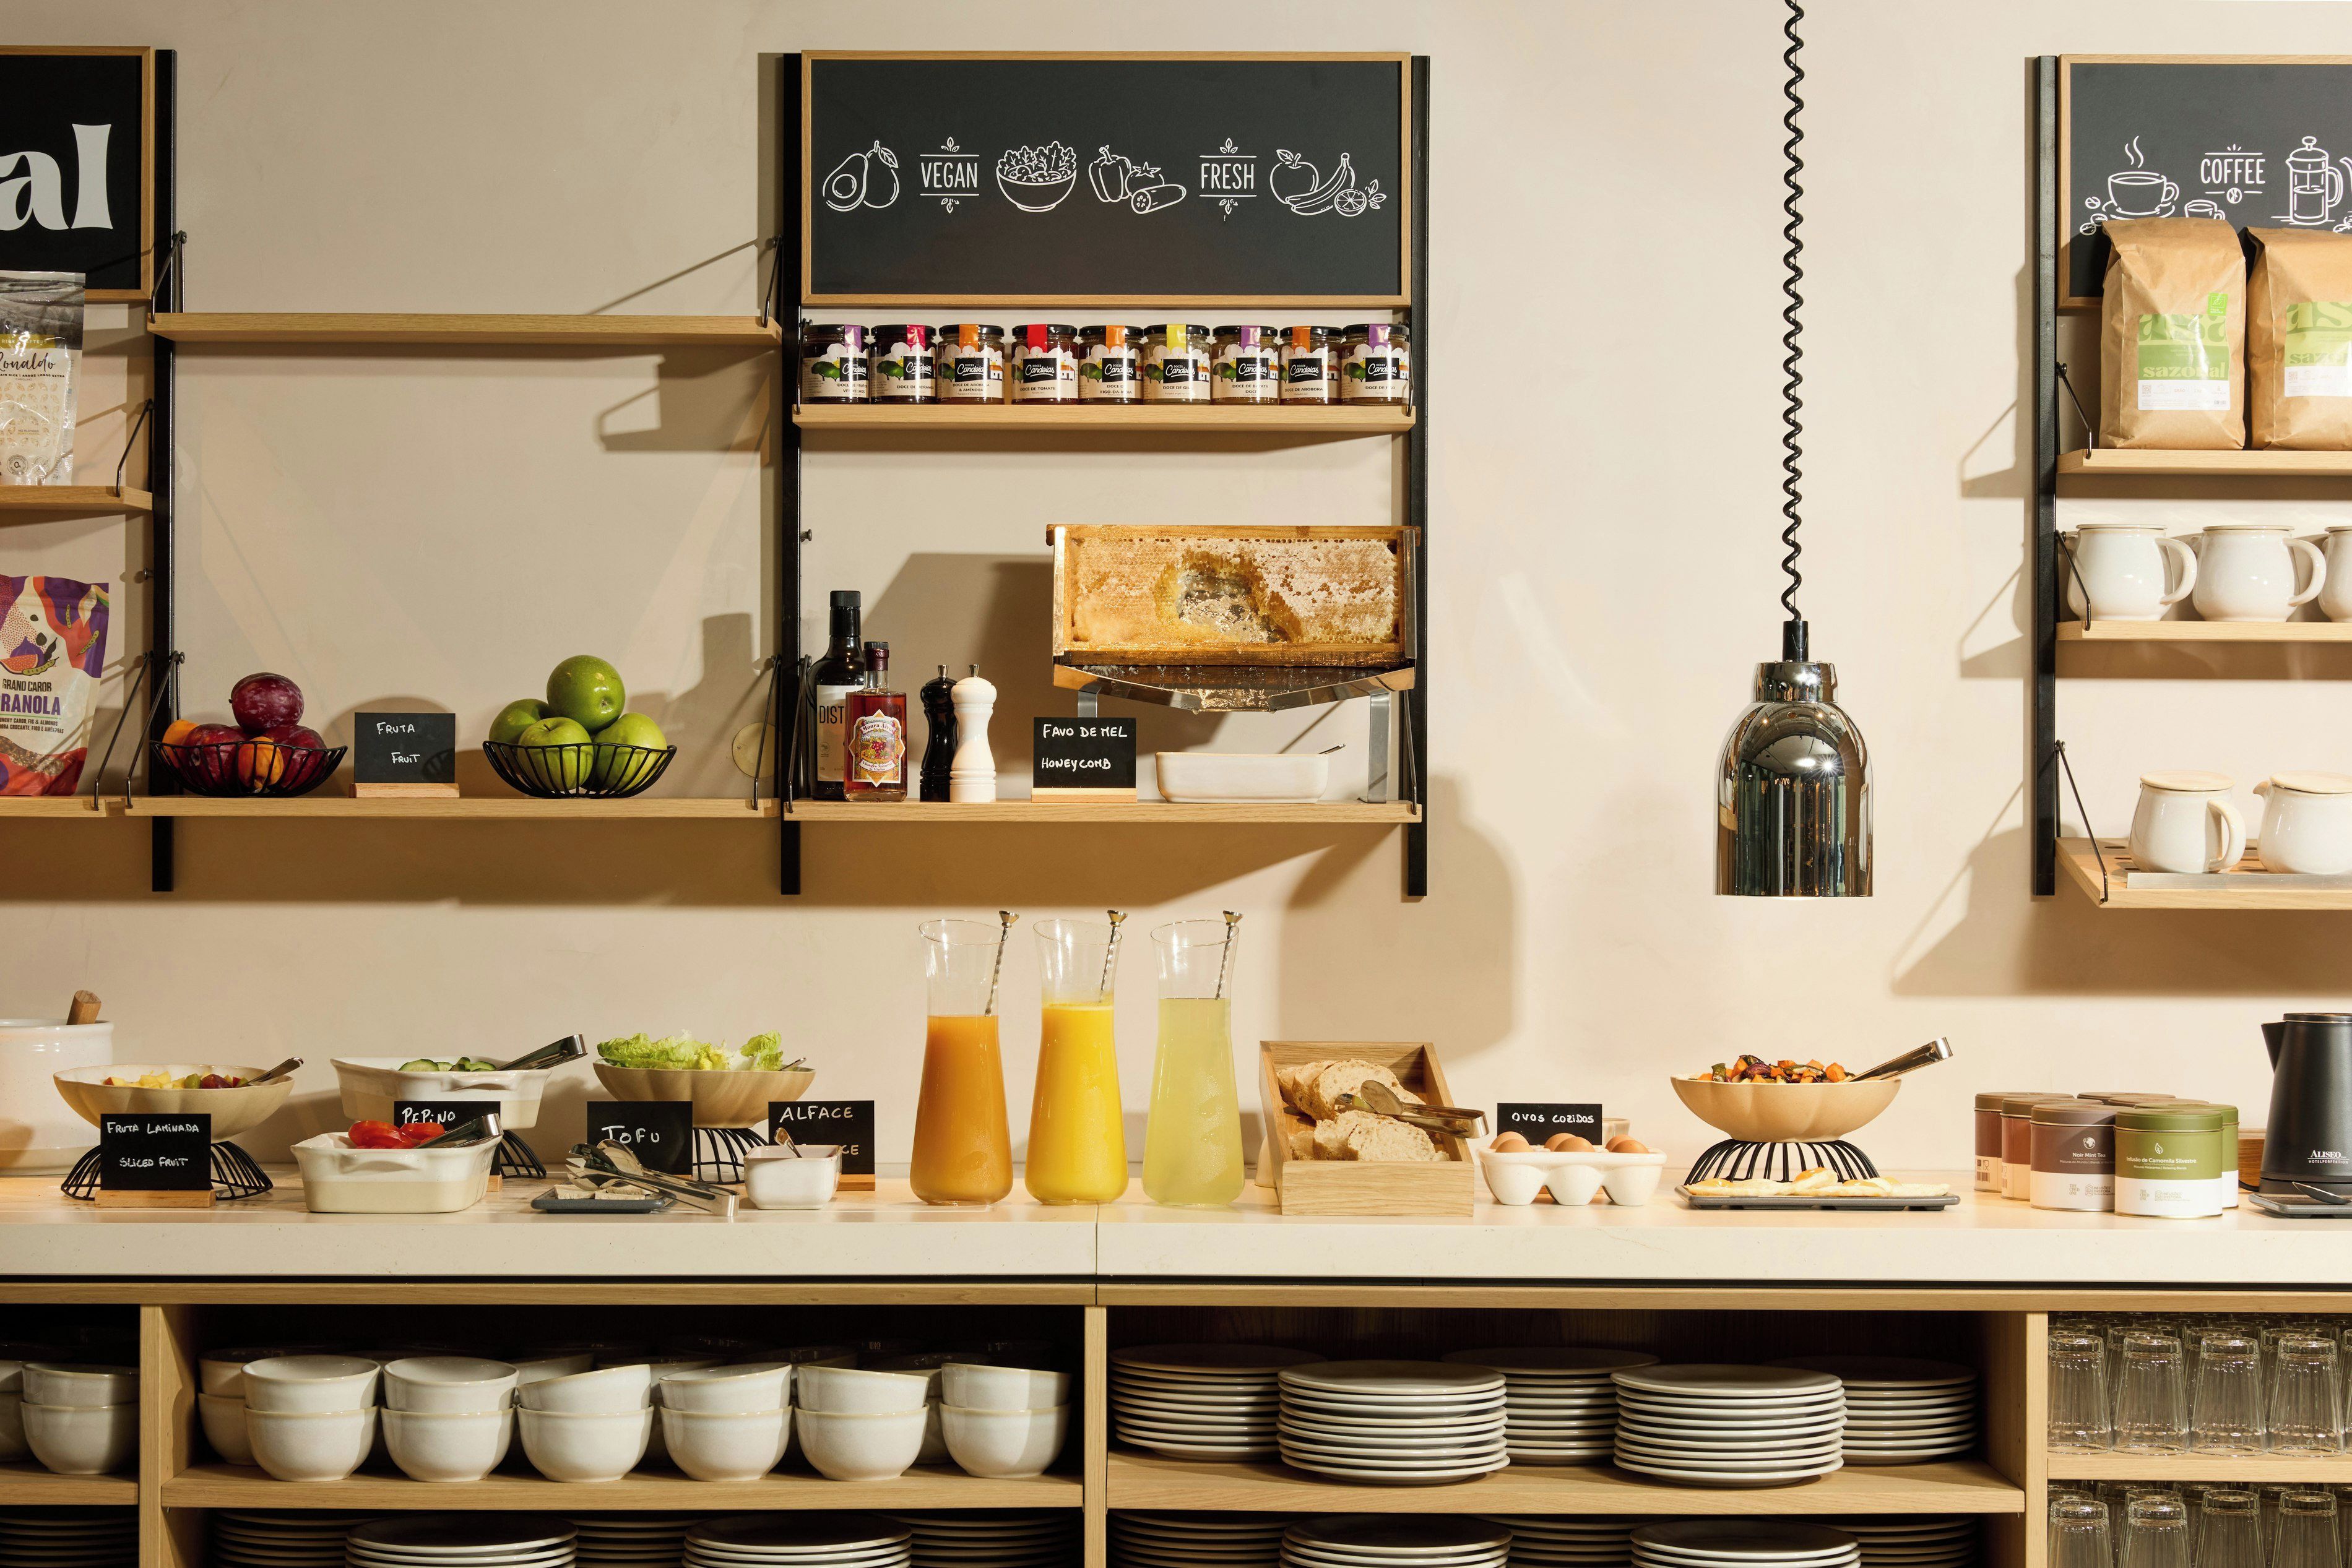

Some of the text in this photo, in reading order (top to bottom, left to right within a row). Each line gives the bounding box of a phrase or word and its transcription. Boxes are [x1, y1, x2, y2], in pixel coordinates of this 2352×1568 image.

[921, 162, 978, 188] VEGAN
[1201, 163, 1255, 189] FRESH
[2200, 158, 2266, 184] COFFEE
[1025, 364, 1055, 376] Candeias
[1290, 364, 1319, 376] Candeias
[2, 678, 52, 692] GRAND CAROB
[0, 693, 61, 715] RANOLA
[376, 722, 415, 734] FRUTA
[862, 724, 880, 732] Moura
[1043, 724, 1128, 738] FAVO DE MEL
[779, 1105, 854, 1123] ALFACE
[1511, 1112, 1545, 1122] OVOS
[106, 1122, 139, 1134] FRUTA
[601, 1125, 660, 1144] TOFU
[2310, 1150, 2341, 1158] ALISEO
